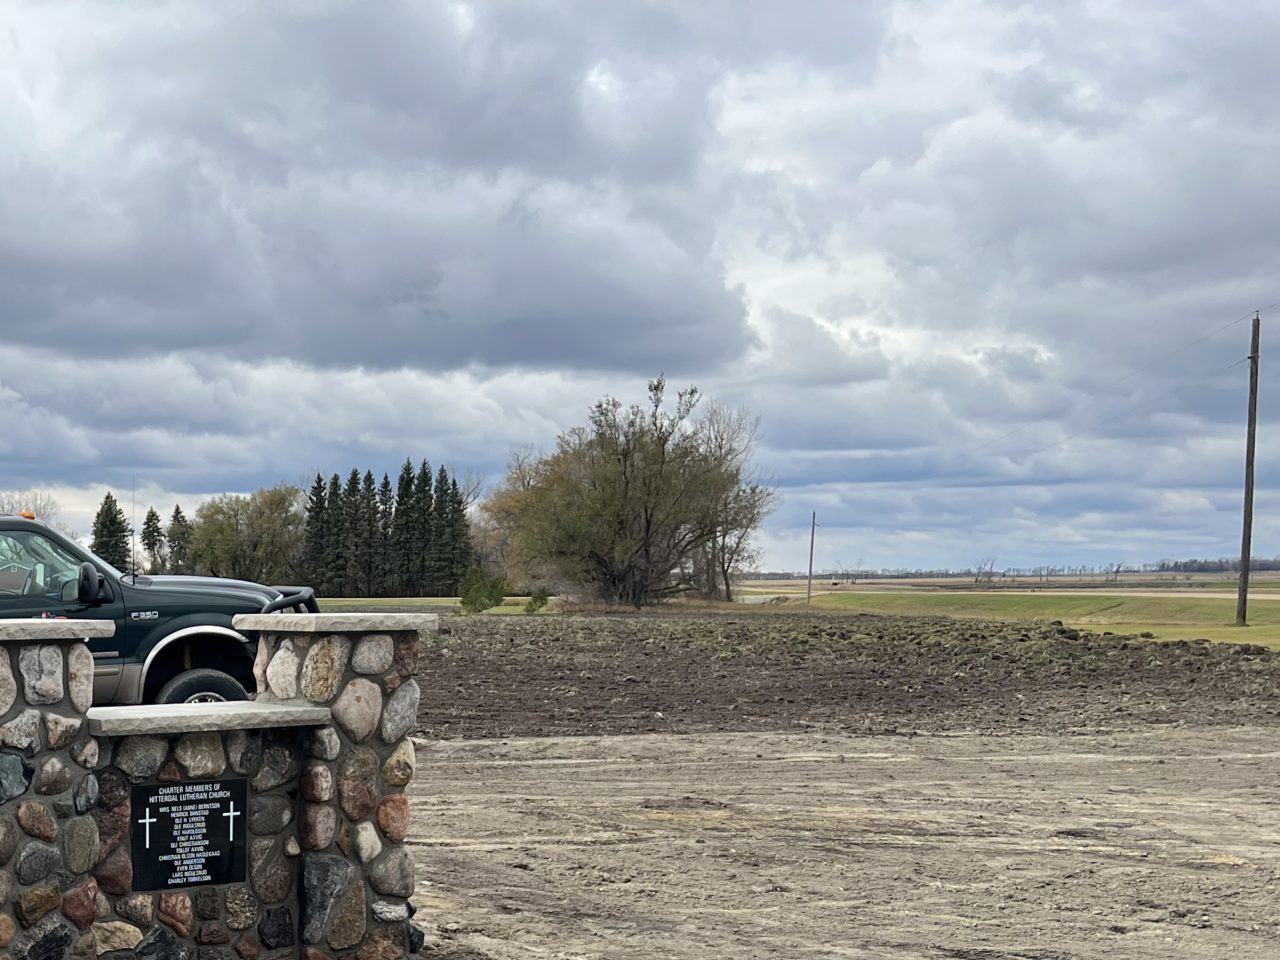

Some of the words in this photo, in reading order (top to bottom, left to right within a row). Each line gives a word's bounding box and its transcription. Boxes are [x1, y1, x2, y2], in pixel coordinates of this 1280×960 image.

[159, 786, 184, 795] CHARTER
[185, 784, 212, 792] MEMBERS
[149, 794, 178, 803] HITTERDAL
[180, 792, 208, 801] LUTHERAN
[209, 790, 231, 799] CHURCH
